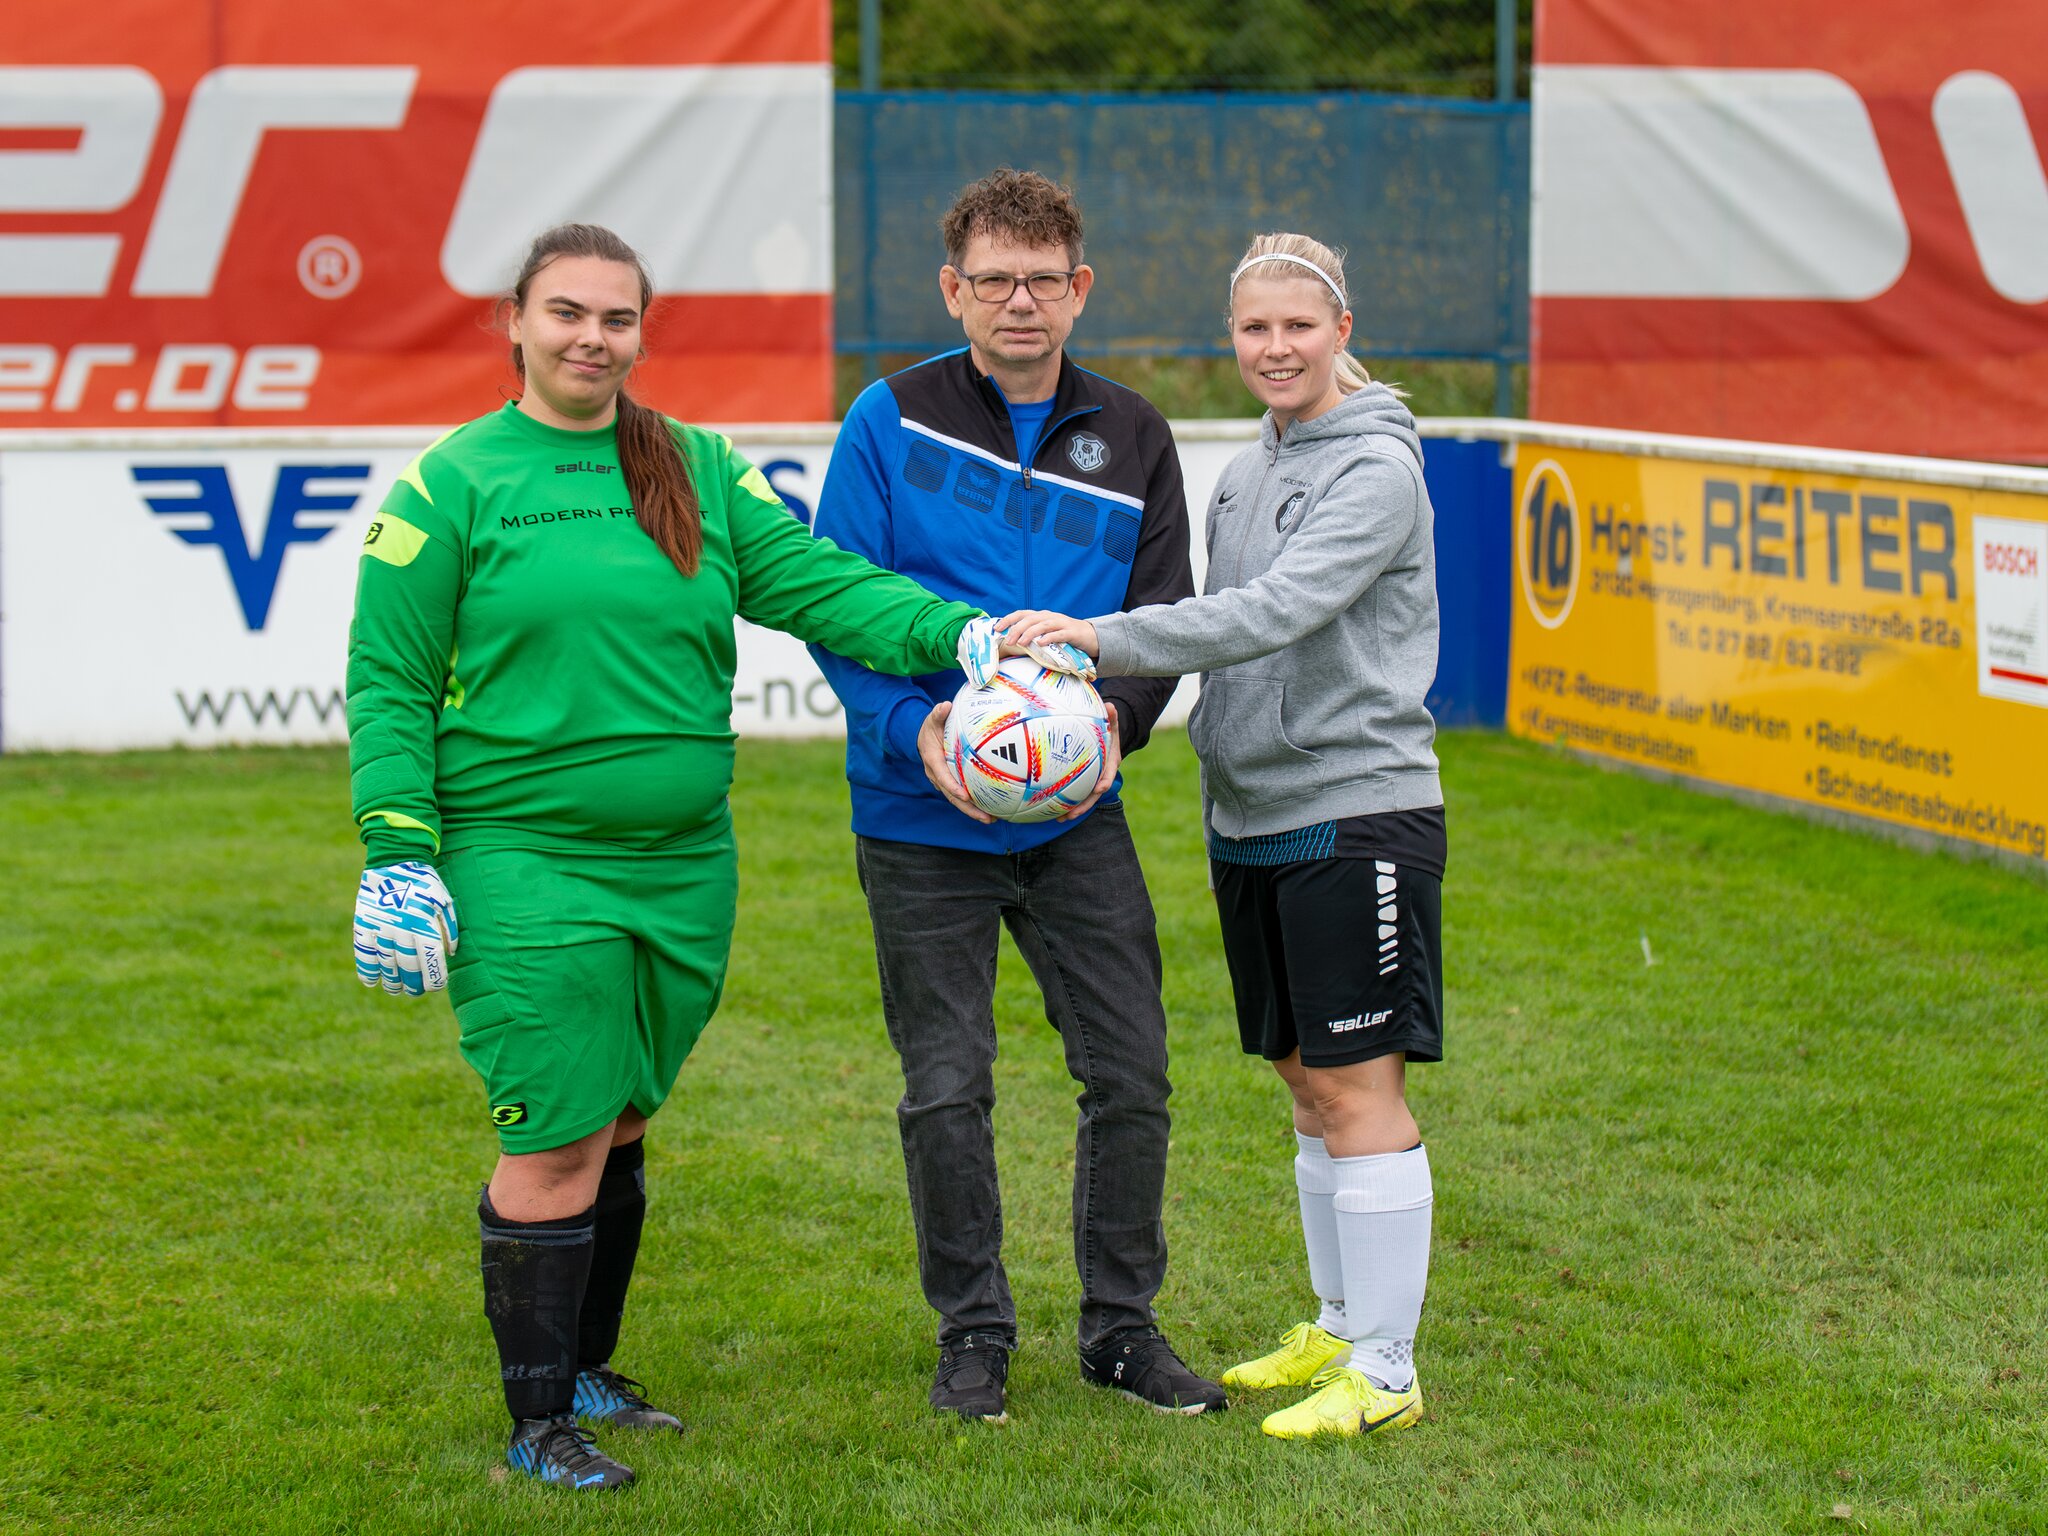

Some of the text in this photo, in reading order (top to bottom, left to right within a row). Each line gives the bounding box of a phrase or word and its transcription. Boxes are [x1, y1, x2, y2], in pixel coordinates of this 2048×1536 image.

[1590, 478, 1958, 601] Horst REITER
[1984, 542, 2038, 577] BOSCH
[1711, 700, 1791, 741] Marken
[1816, 720, 1953, 777] Reifendienst
[1816, 765, 2046, 856] Schadensabwicklung
